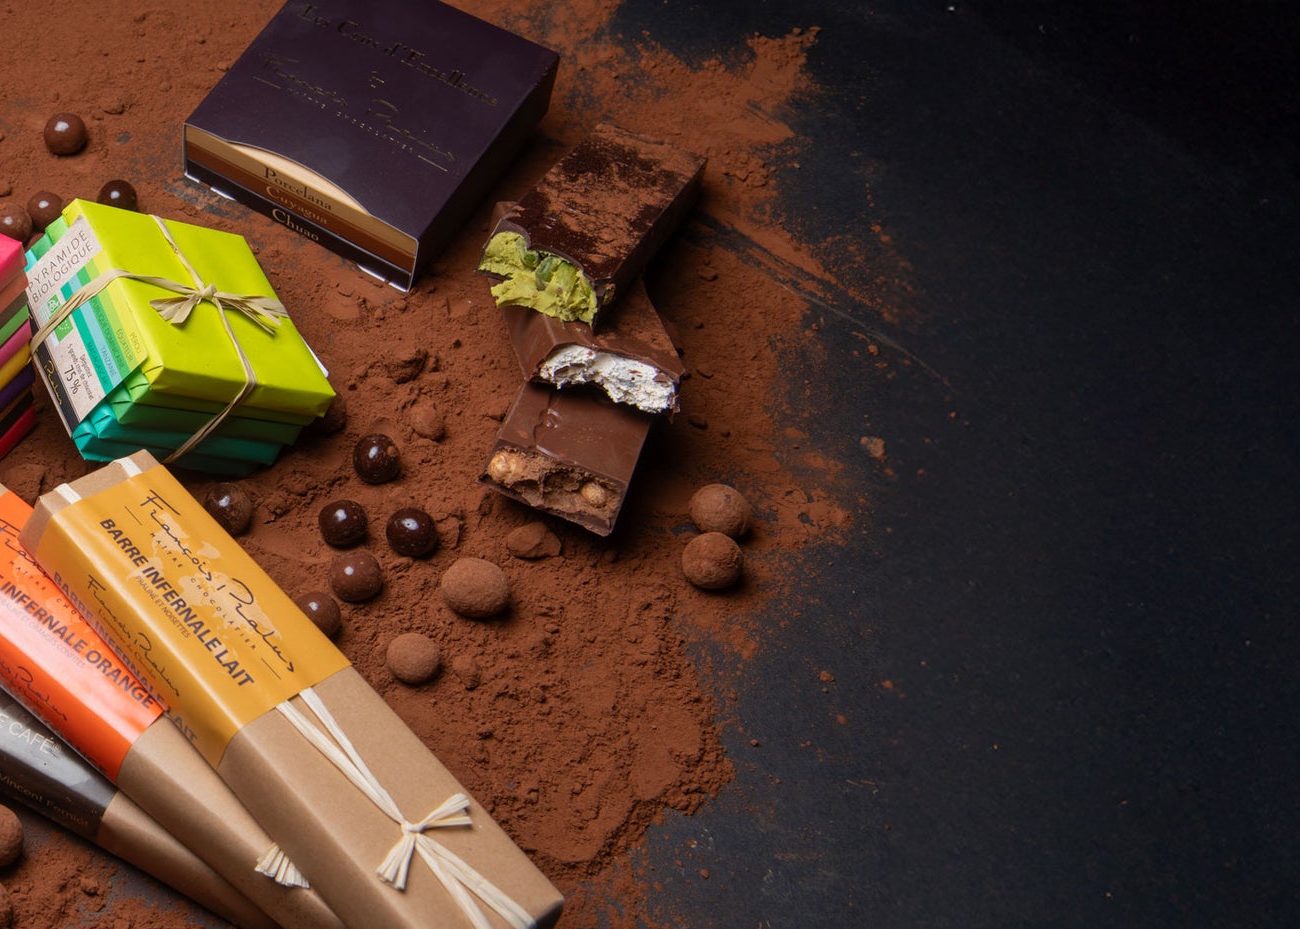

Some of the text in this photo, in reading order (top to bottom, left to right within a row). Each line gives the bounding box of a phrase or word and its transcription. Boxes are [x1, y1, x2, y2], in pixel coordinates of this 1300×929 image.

[301, 4, 330, 28] Les
[263, 166, 332, 211] Porcelana
[266, 185, 328, 226] Cuyagua
[272, 208, 319, 242] Chuao
[27, 230, 87, 293] PYRAMIDE
[32, 241, 94, 304] BIOLOGIQUE
[52, 572, 96, 622] BARRE
[99, 517, 148, 567] BARRE
[141, 566, 221, 652] INFERNALE
[214, 649, 254, 687] LAIT
[134, 574, 191, 638] PRALINÉ ET NOISETTES
[140, 490, 296, 673] François Pralus
[189, 576, 256, 651] CHOCOLATIER
[85, 649, 156, 710] ORANGE
[132, 632, 179, 696] Pralus
